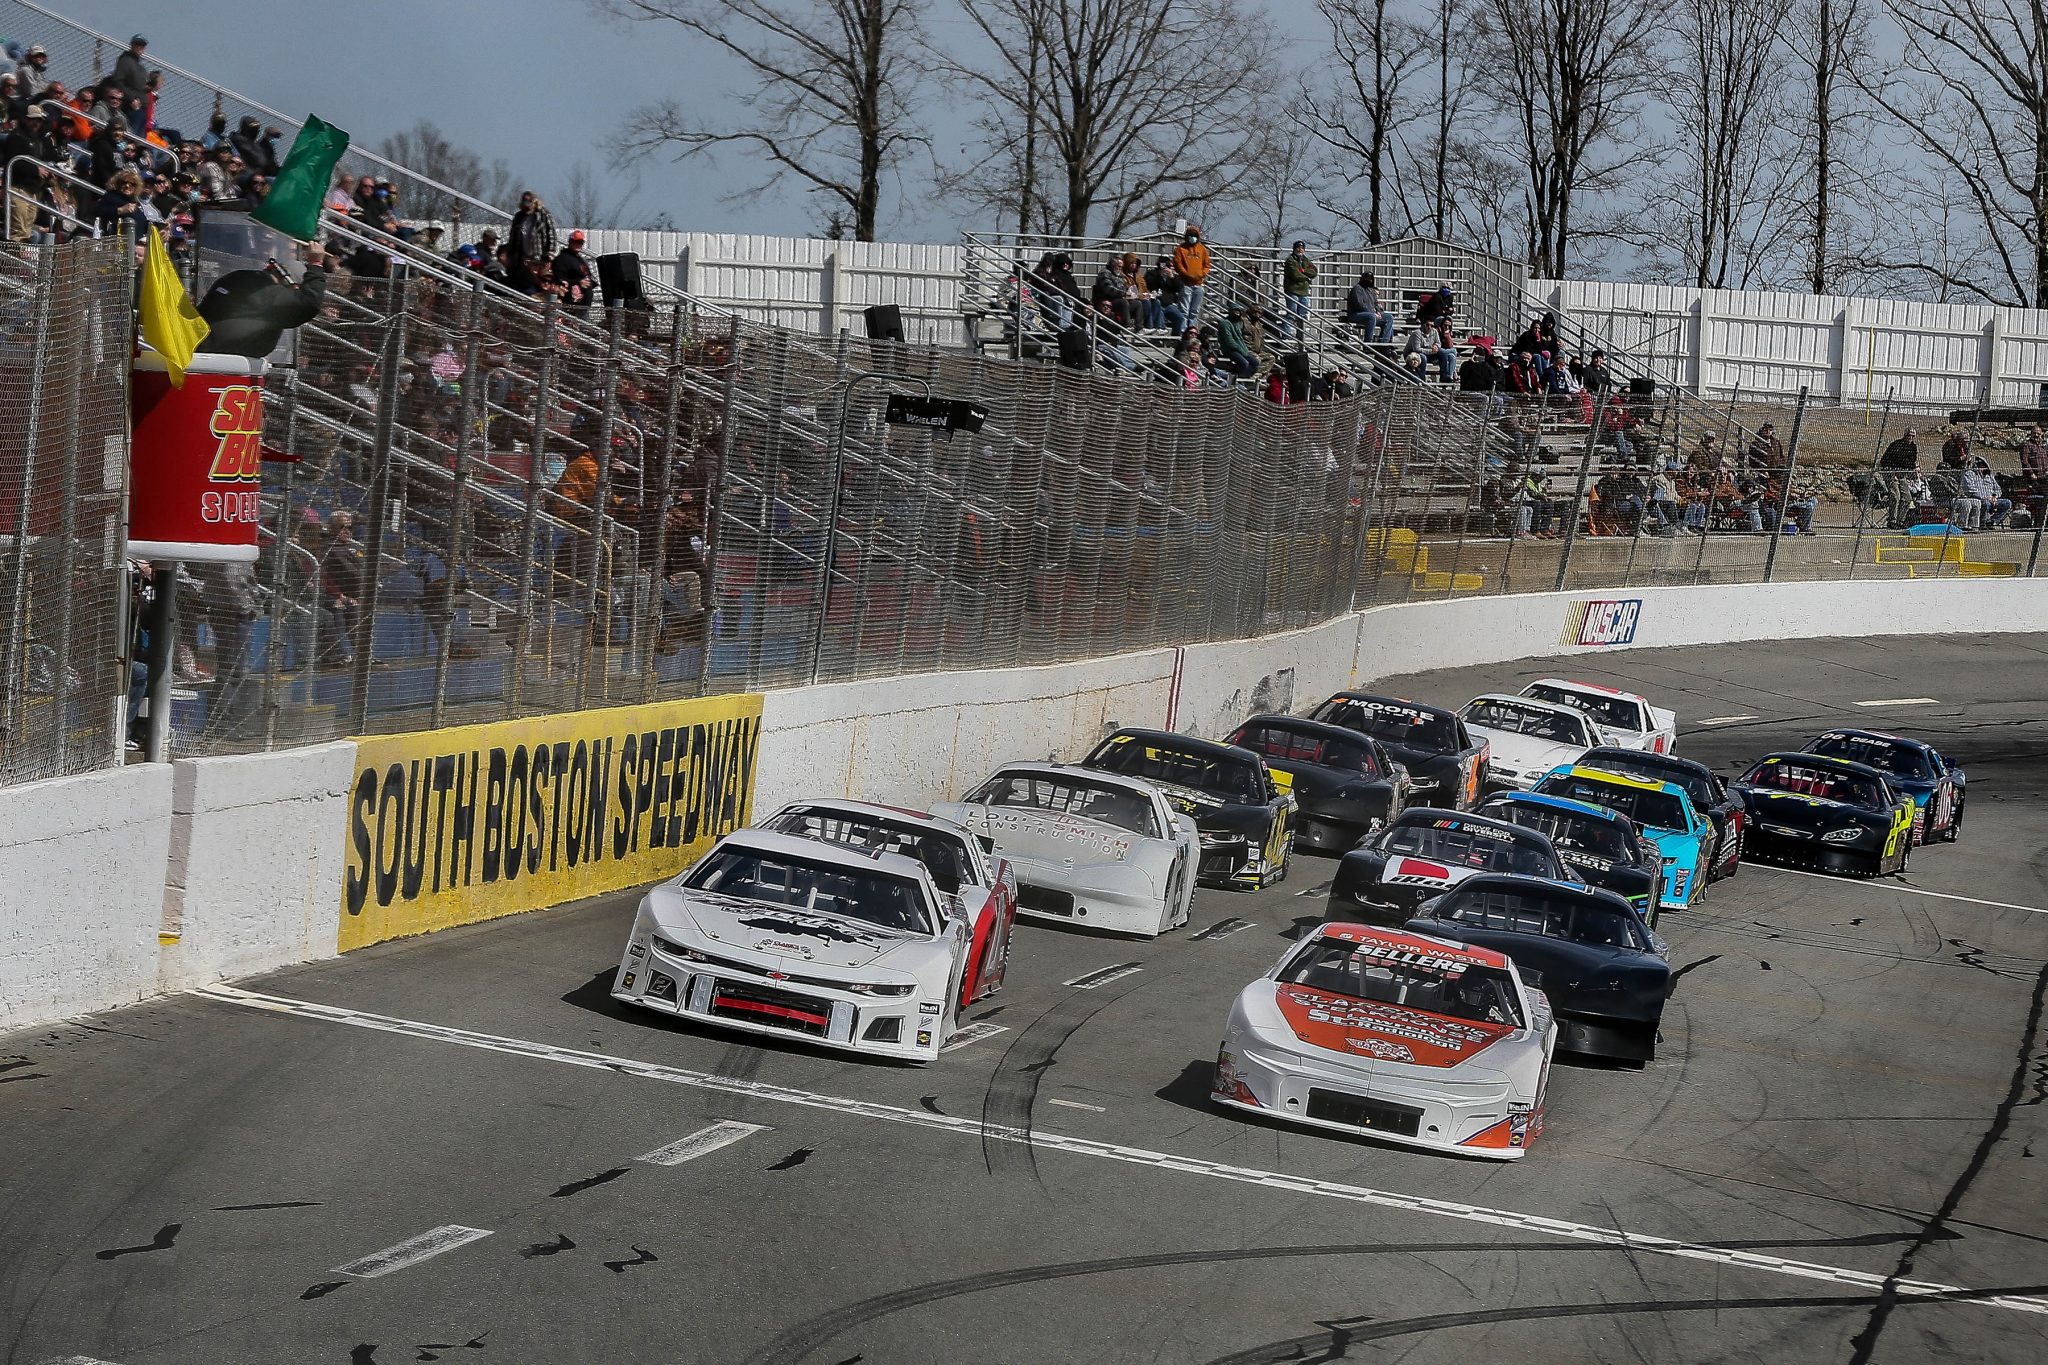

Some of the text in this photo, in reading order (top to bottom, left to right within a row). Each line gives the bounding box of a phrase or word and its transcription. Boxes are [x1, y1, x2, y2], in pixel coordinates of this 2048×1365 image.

[906, 412, 948, 427] WHELEN
[1579, 602, 1639, 643] NASCAR
[1347, 699, 1435, 722] MOORE
[346, 714, 762, 917] SOUTH BOSTON SPEEDWAY
[965, 819, 1127, 859] CONSTRUCTION
[1053, 823, 1130, 849] SMITH
[1360, 935, 1421, 953] TAYLOR
[1354, 944, 1470, 973] SELLERS
